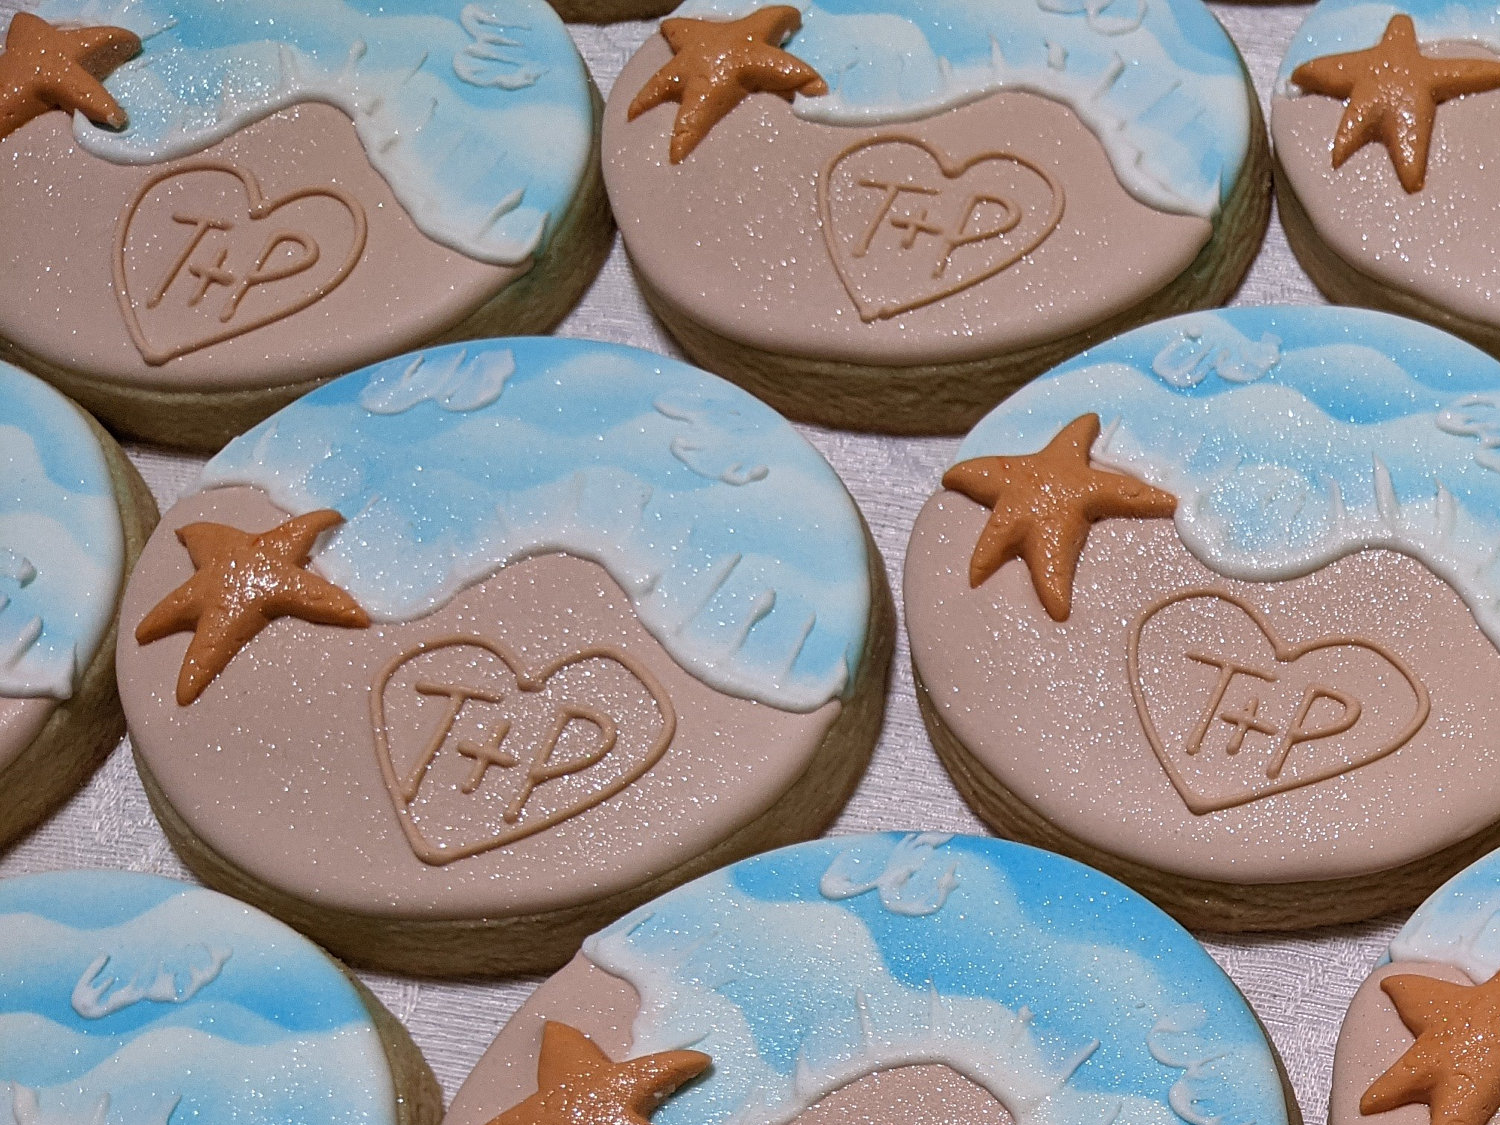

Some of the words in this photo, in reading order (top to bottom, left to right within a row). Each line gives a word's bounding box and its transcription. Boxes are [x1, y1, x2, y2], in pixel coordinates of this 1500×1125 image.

[147, 214, 319, 323] T+P
[853, 180, 1021, 278] T+P
[402, 681, 618, 824] T+P
[1186, 651, 1362, 780] T+P
